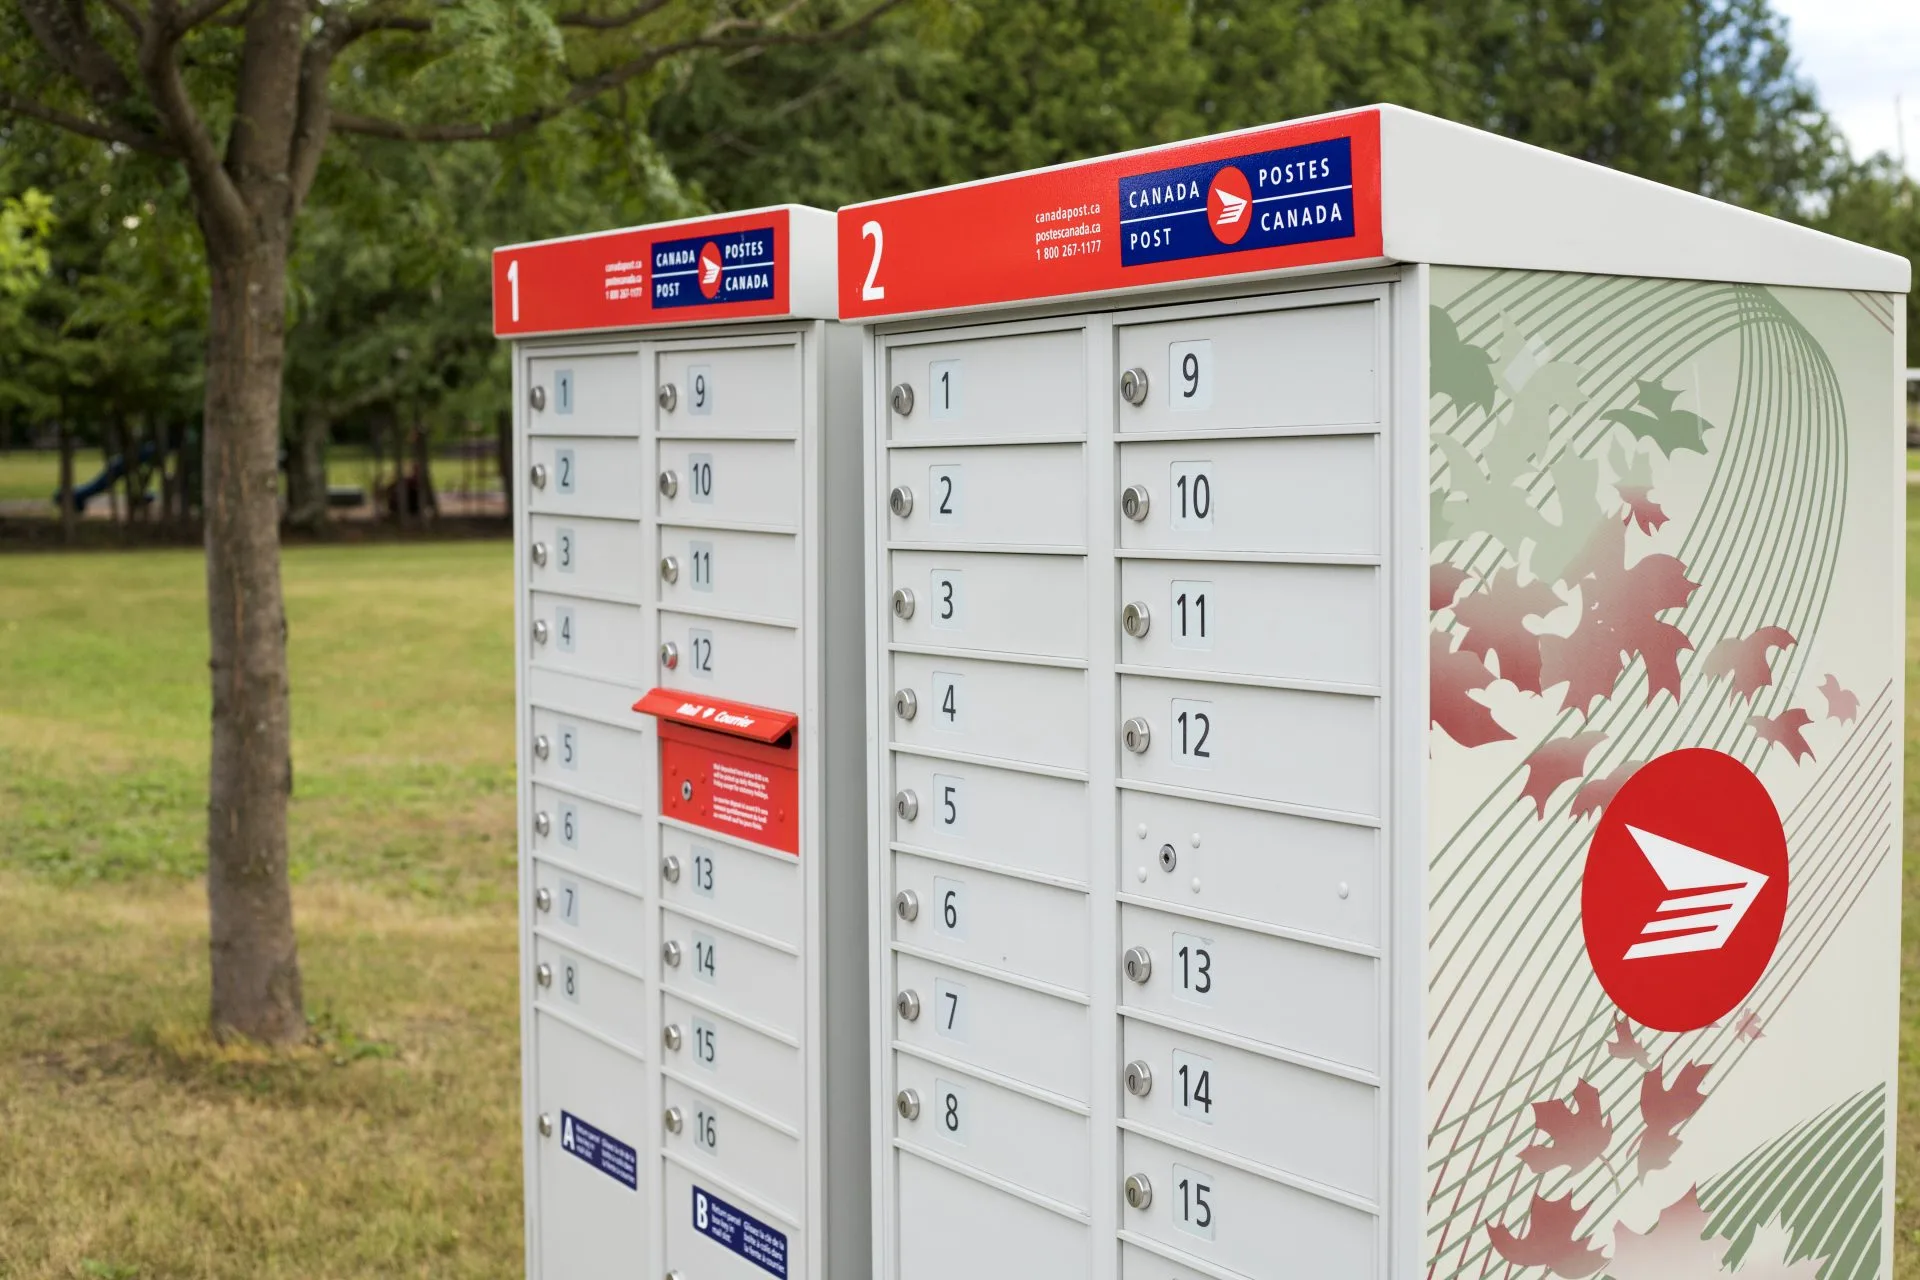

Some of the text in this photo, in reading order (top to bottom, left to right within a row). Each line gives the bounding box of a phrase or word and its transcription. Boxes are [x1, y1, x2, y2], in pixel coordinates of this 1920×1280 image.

[1259, 157, 1330, 187] POSTES
[1129, 180, 1201, 209] CANADA
[1035, 203, 1101, 223] canadapost.ca
[1260, 201, 1343, 232] CANADA
[725, 240, 764, 259] POSTES
[1035, 222, 1101, 245] postescanada.ca
[1036, 239, 1102, 261] 1 800 267-1177
[1130, 227, 1172, 250] POST
[656, 249, 696, 267] CANADA
[863, 220, 885, 302] 2
[507, 260, 520, 322] 1
[656, 282, 680, 298] POST
[725, 275, 769, 292] CANADA
[695, 374, 705, 408] 9
[941, 371, 949, 410] 1
[1182, 352, 1199, 398] 9
[561, 457, 570, 487] 2
[692, 463, 712, 496] 10
[939, 475, 953, 515] 2
[1176, 473, 1210, 519] 10
[562, 536, 570, 567] 3
[693, 551, 710, 584] 11
[941, 580, 954, 620] 3
[1176, 593, 1205, 638] 11
[562, 616, 571, 646] 4
[693, 638, 712, 672] 12
[714, 710, 755, 728] Courrier
[942, 684, 957, 722] 4
[564, 733, 572, 763] 5
[1177, 711, 1210, 758] 12
[944, 786, 956, 825] 5
[564, 811, 573, 841] 6
[695, 855, 713, 891] 13
[565, 888, 574, 917] 7
[944, 890, 957, 929] 6
[696, 941, 715, 977] 14
[1178, 946, 1211, 994] 13
[566, 966, 574, 996] 8
[945, 991, 958, 1030] 7
[696, 1027, 715, 1063] 15
[1178, 1064, 1213, 1114] 14
[697, 1111, 716, 1148] 16
[945, 1093, 959, 1132] 8
[563, 1116, 575, 1150] A
[696, 1192, 708, 1230] B
[1178, 1178, 1212, 1228] 15
